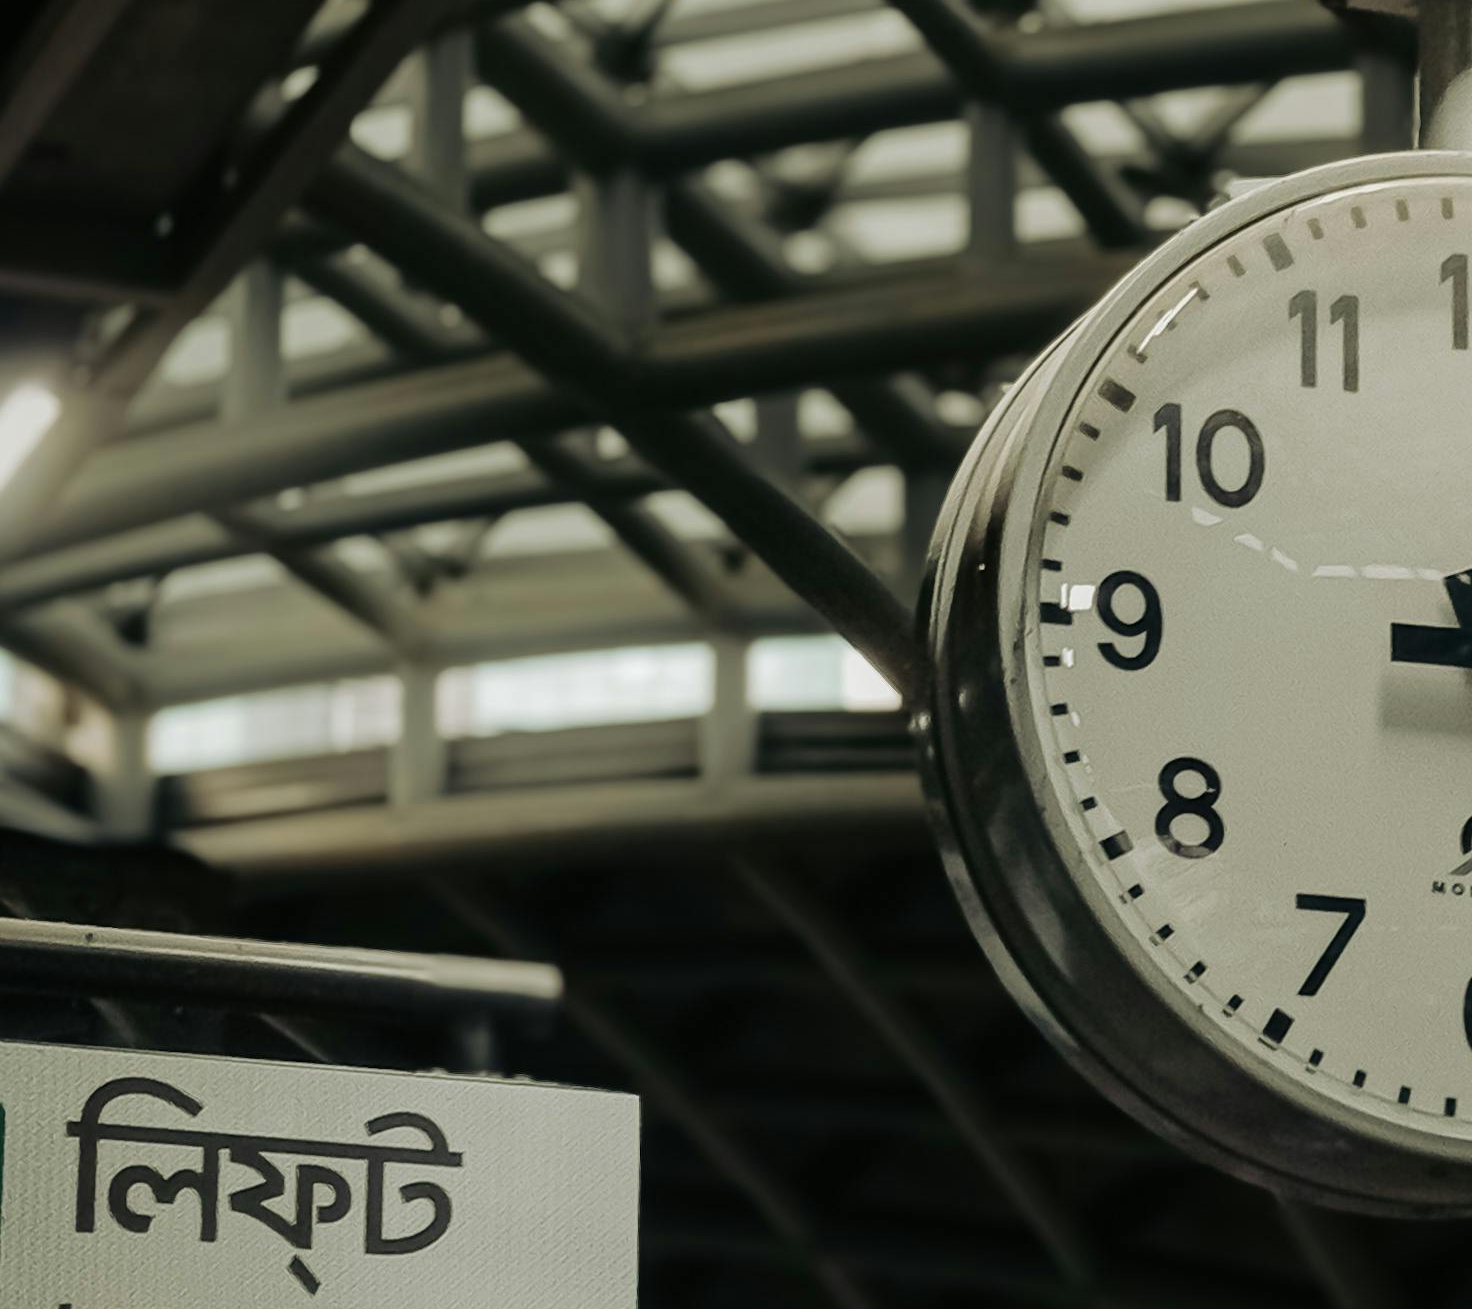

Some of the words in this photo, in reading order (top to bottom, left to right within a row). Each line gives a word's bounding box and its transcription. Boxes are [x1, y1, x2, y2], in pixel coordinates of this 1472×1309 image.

[1288, 289, 1360, 394] 11
[1153, 402, 1265, 509] 10
[1096, 570, 1163, 672] 9
[1154, 756, 1226, 860] 8
[1295, 893, 1367, 997] 7
